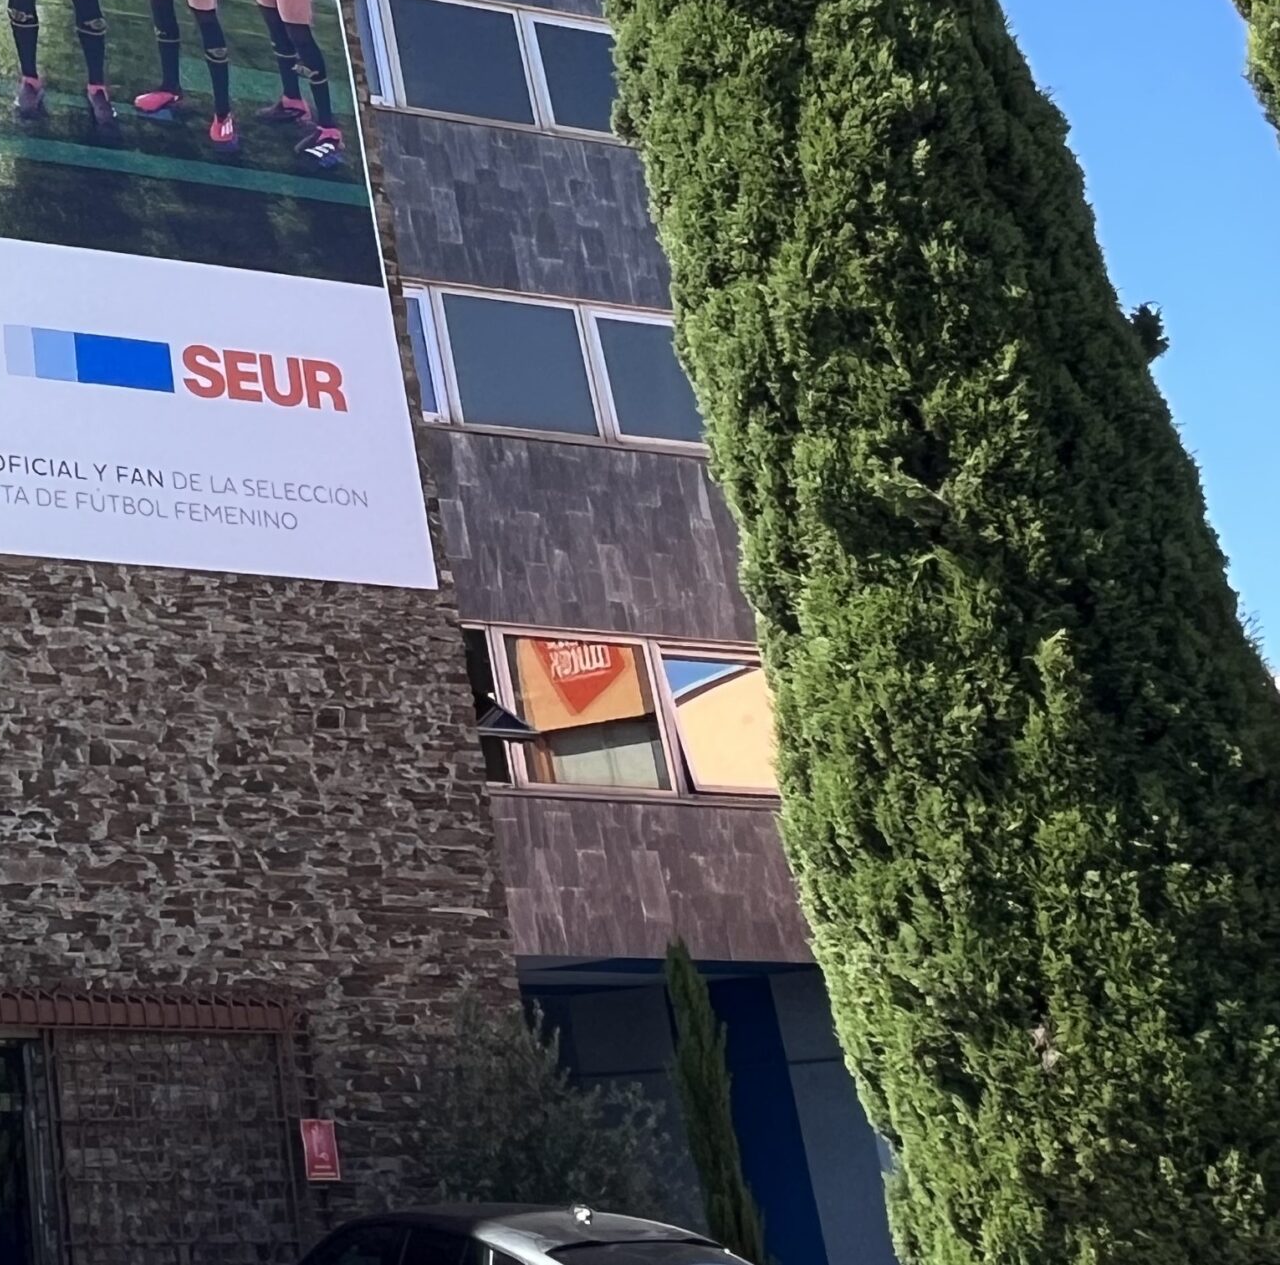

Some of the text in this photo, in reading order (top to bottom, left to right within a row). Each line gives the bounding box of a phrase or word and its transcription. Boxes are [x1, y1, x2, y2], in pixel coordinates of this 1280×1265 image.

[182, 344, 348, 413] SEUR
[93, 463, 108, 483] Y
[116, 466, 164, 488] FAN
[172, 471, 203, 492] DE
[210, 474, 238, 495] LA
[36, 488, 68, 509] DE
[174, 501, 298, 530] FEMENINO
